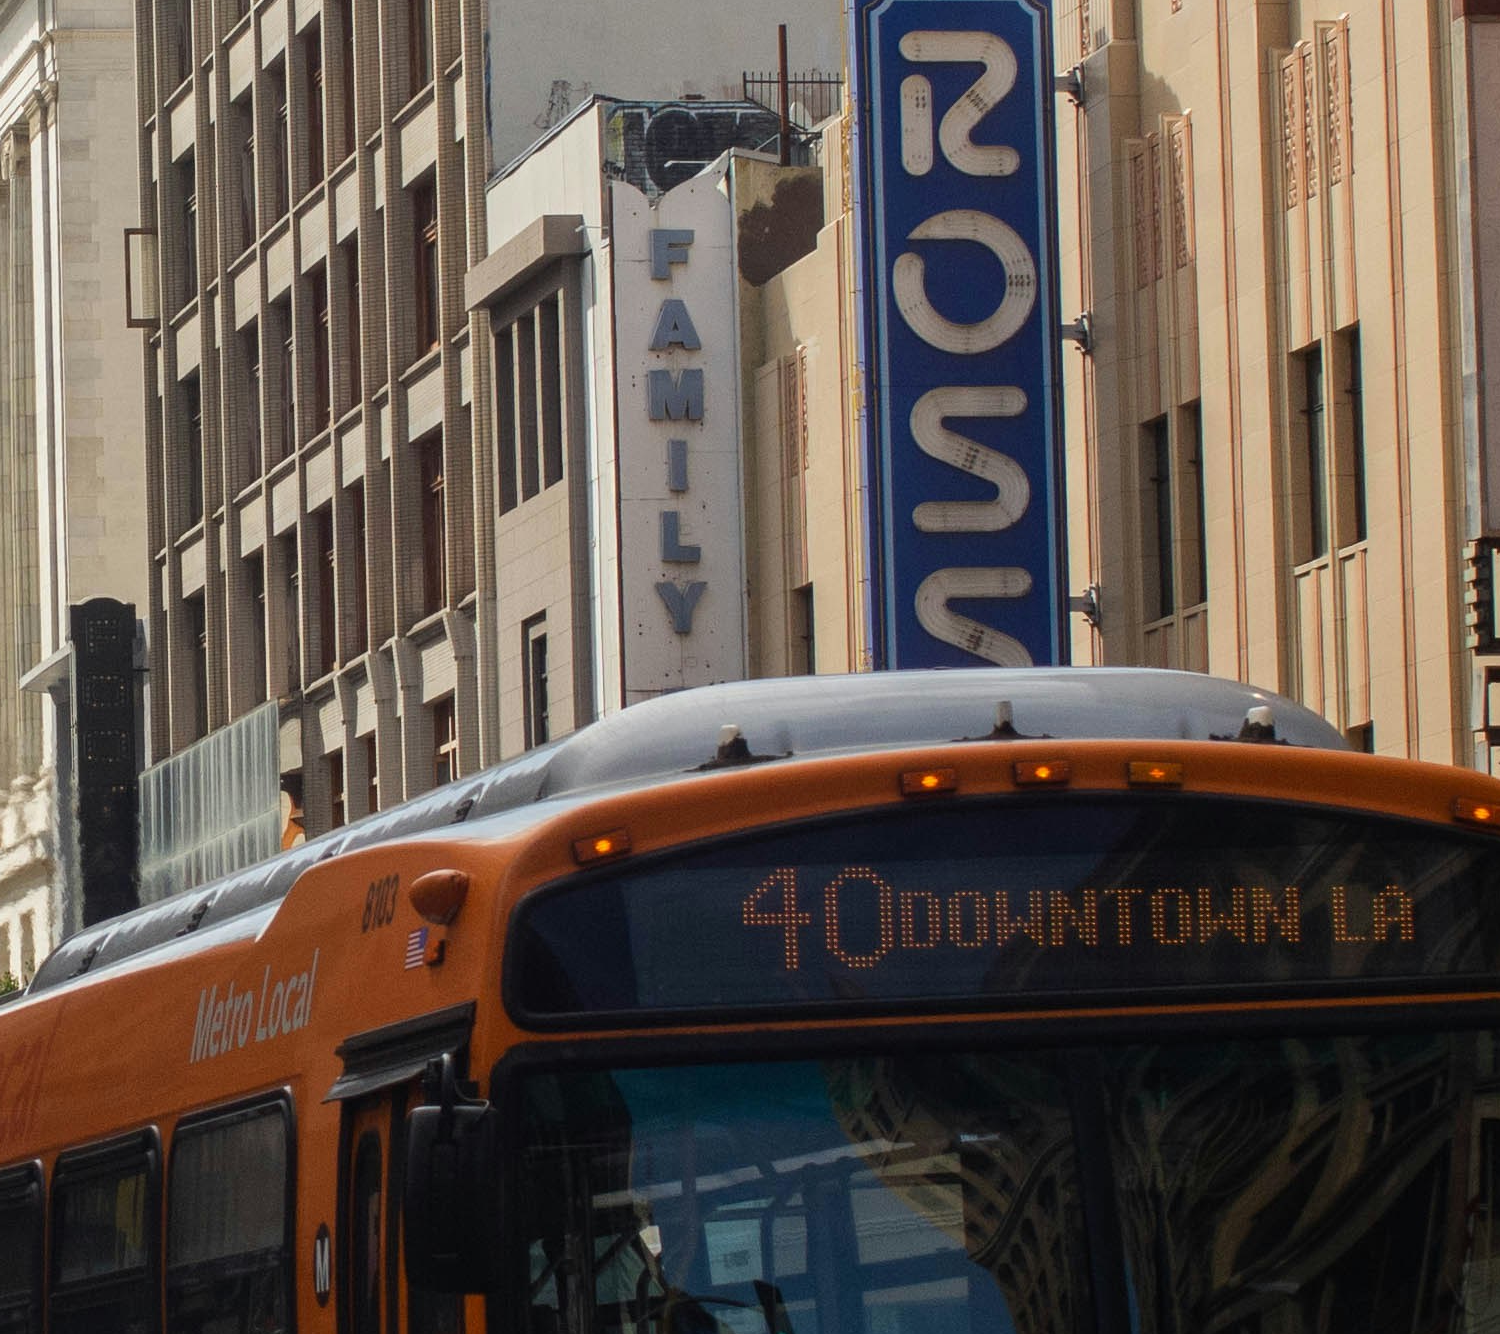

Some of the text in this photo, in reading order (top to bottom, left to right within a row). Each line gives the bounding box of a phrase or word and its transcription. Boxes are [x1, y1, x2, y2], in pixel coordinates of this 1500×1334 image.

[647, 228, 706, 635] FAMILY
[892, 29, 1036, 667] ROSS
[189, 947, 321, 1063] Metro Local
[741, 866, 1415, 970] 40 DOWNTOWN LA
